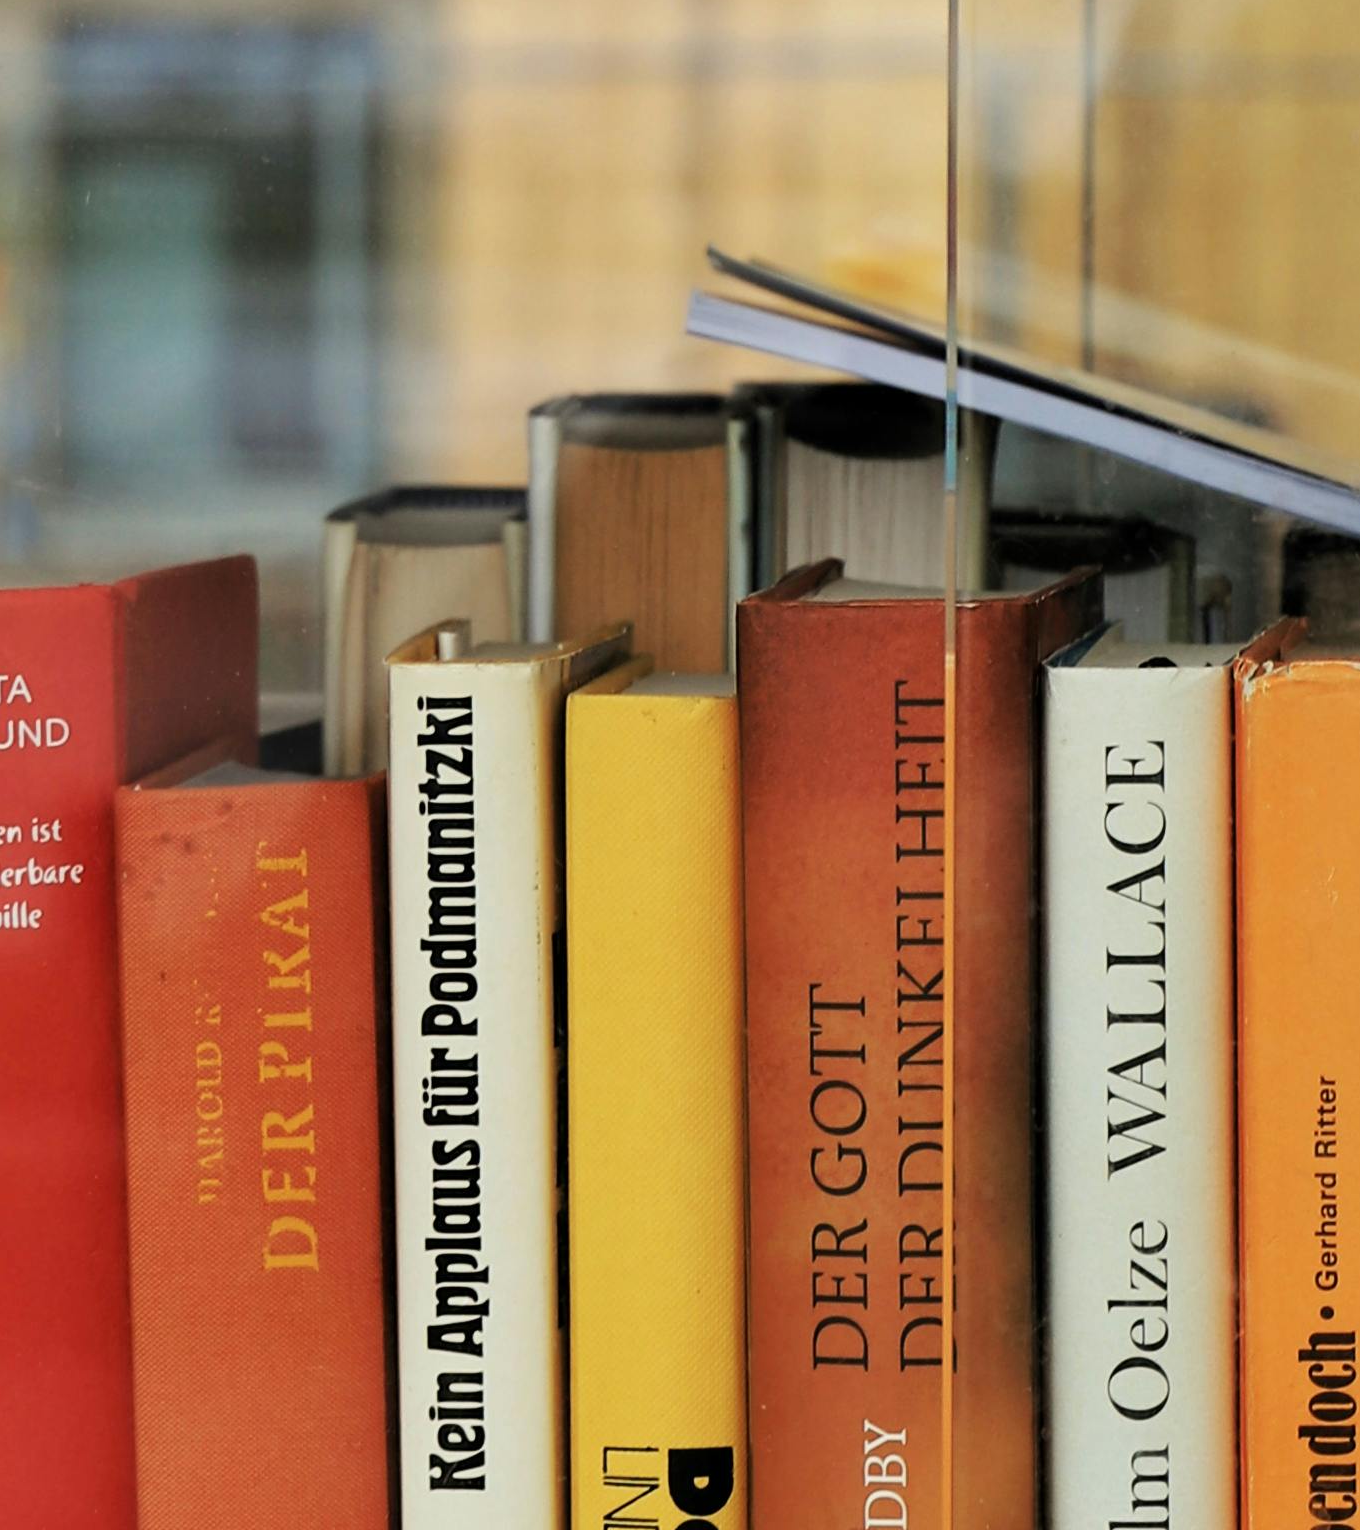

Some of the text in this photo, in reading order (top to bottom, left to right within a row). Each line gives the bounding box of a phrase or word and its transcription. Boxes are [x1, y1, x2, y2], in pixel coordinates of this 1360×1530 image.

[31, 819, 63, 843] ist
[1105, 740, 1168, 1183] WALLACE
[418, 693, 489, 1491] Kein Applaus für Podmanitzki
[1315, 1074, 1337, 1157] Ritter
[809, 982, 868, 1372] DER GOTT
[1315, 1165, 1338, 1291] Gerhard
[1107, 1220, 1170, 1420] Oelze
[1298, 1331, 1357, 1443] doch
